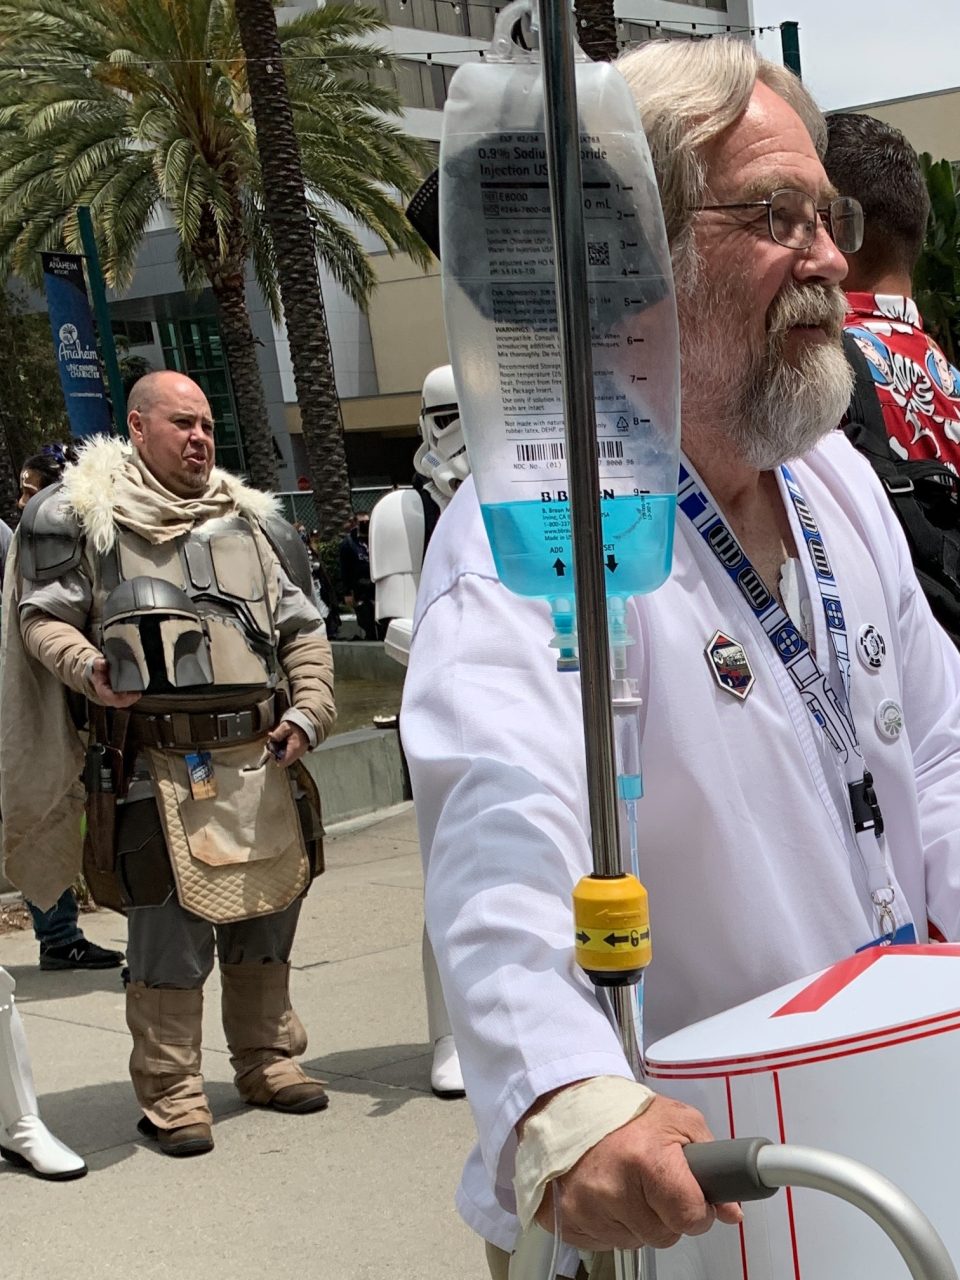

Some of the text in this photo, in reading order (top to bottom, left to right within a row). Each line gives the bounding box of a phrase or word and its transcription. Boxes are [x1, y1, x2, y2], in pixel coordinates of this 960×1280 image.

[514, 146, 546, 160] Sodiu
[480, 164, 549, 178] Injection US
[596, 198, 612, 209] mL
[616, 211, 622, 220] 2
[620, 240, 626, 249] 3
[48, 261, 78, 271] ANAHEIM
[621, 268, 627, 277] 4
[624, 297, 630, 307] 5
[626, 335, 634, 345] 6
[58, 339, 98, 362] Anaheim
[630, 374, 636, 384] 7
[513, 387, 536, 395] Package
[633, 416, 639, 426] 8
[634, 488, 640, 496] 9
